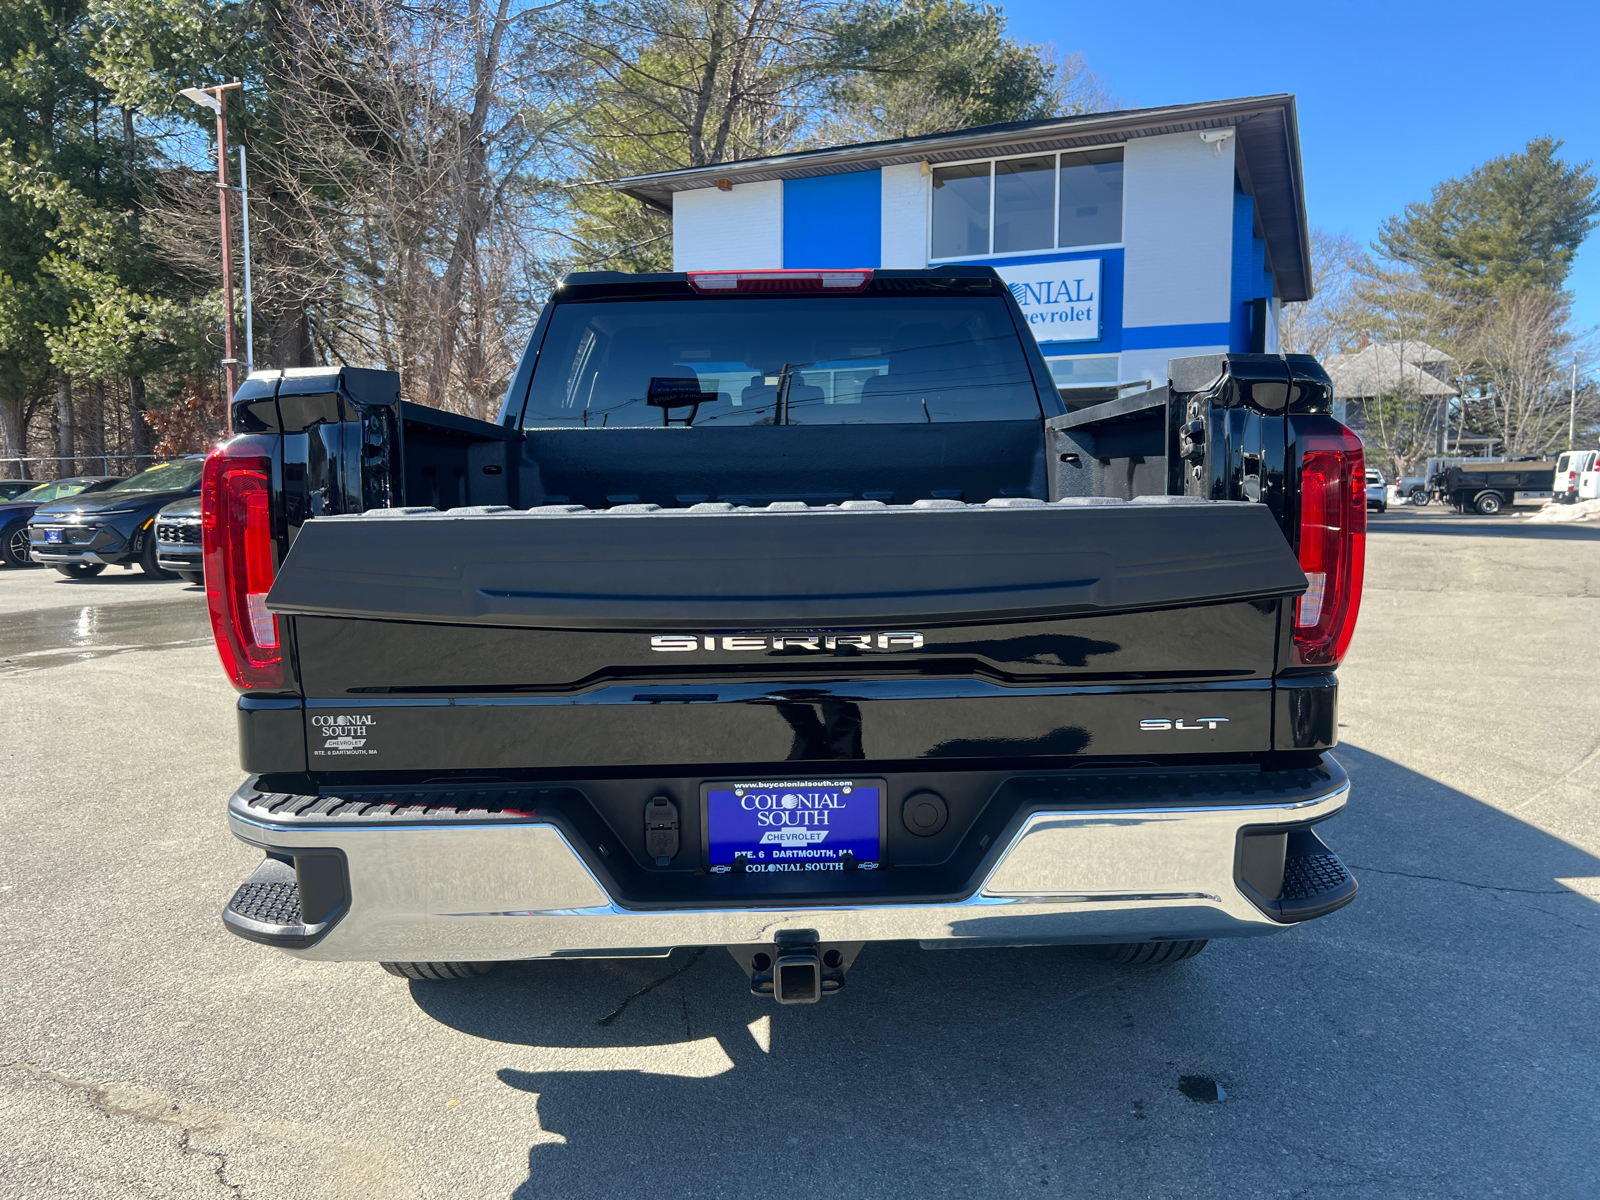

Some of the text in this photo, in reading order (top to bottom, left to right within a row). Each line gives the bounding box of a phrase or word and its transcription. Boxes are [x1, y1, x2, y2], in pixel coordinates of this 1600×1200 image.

[1024, 306, 1093, 324] evrolet
[651, 632, 924, 651] SIERRA
[312, 714, 377, 726] COLONIAL
[1139, 717, 1230, 731] SLT
[322, 726, 367, 736] SOUTH
[734, 780, 853, 789] www.buycolonialsouth.com
[740, 793, 846, 810] COLONIAL
[757, 810, 830, 826] SOUTH
[766, 832, 822, 842] CHEVROLET
[758, 850, 765, 859] 6
[772, 849, 837, 860] DARTMOUTH,
[745, 862, 844, 873] COLONIAL SOUTH
